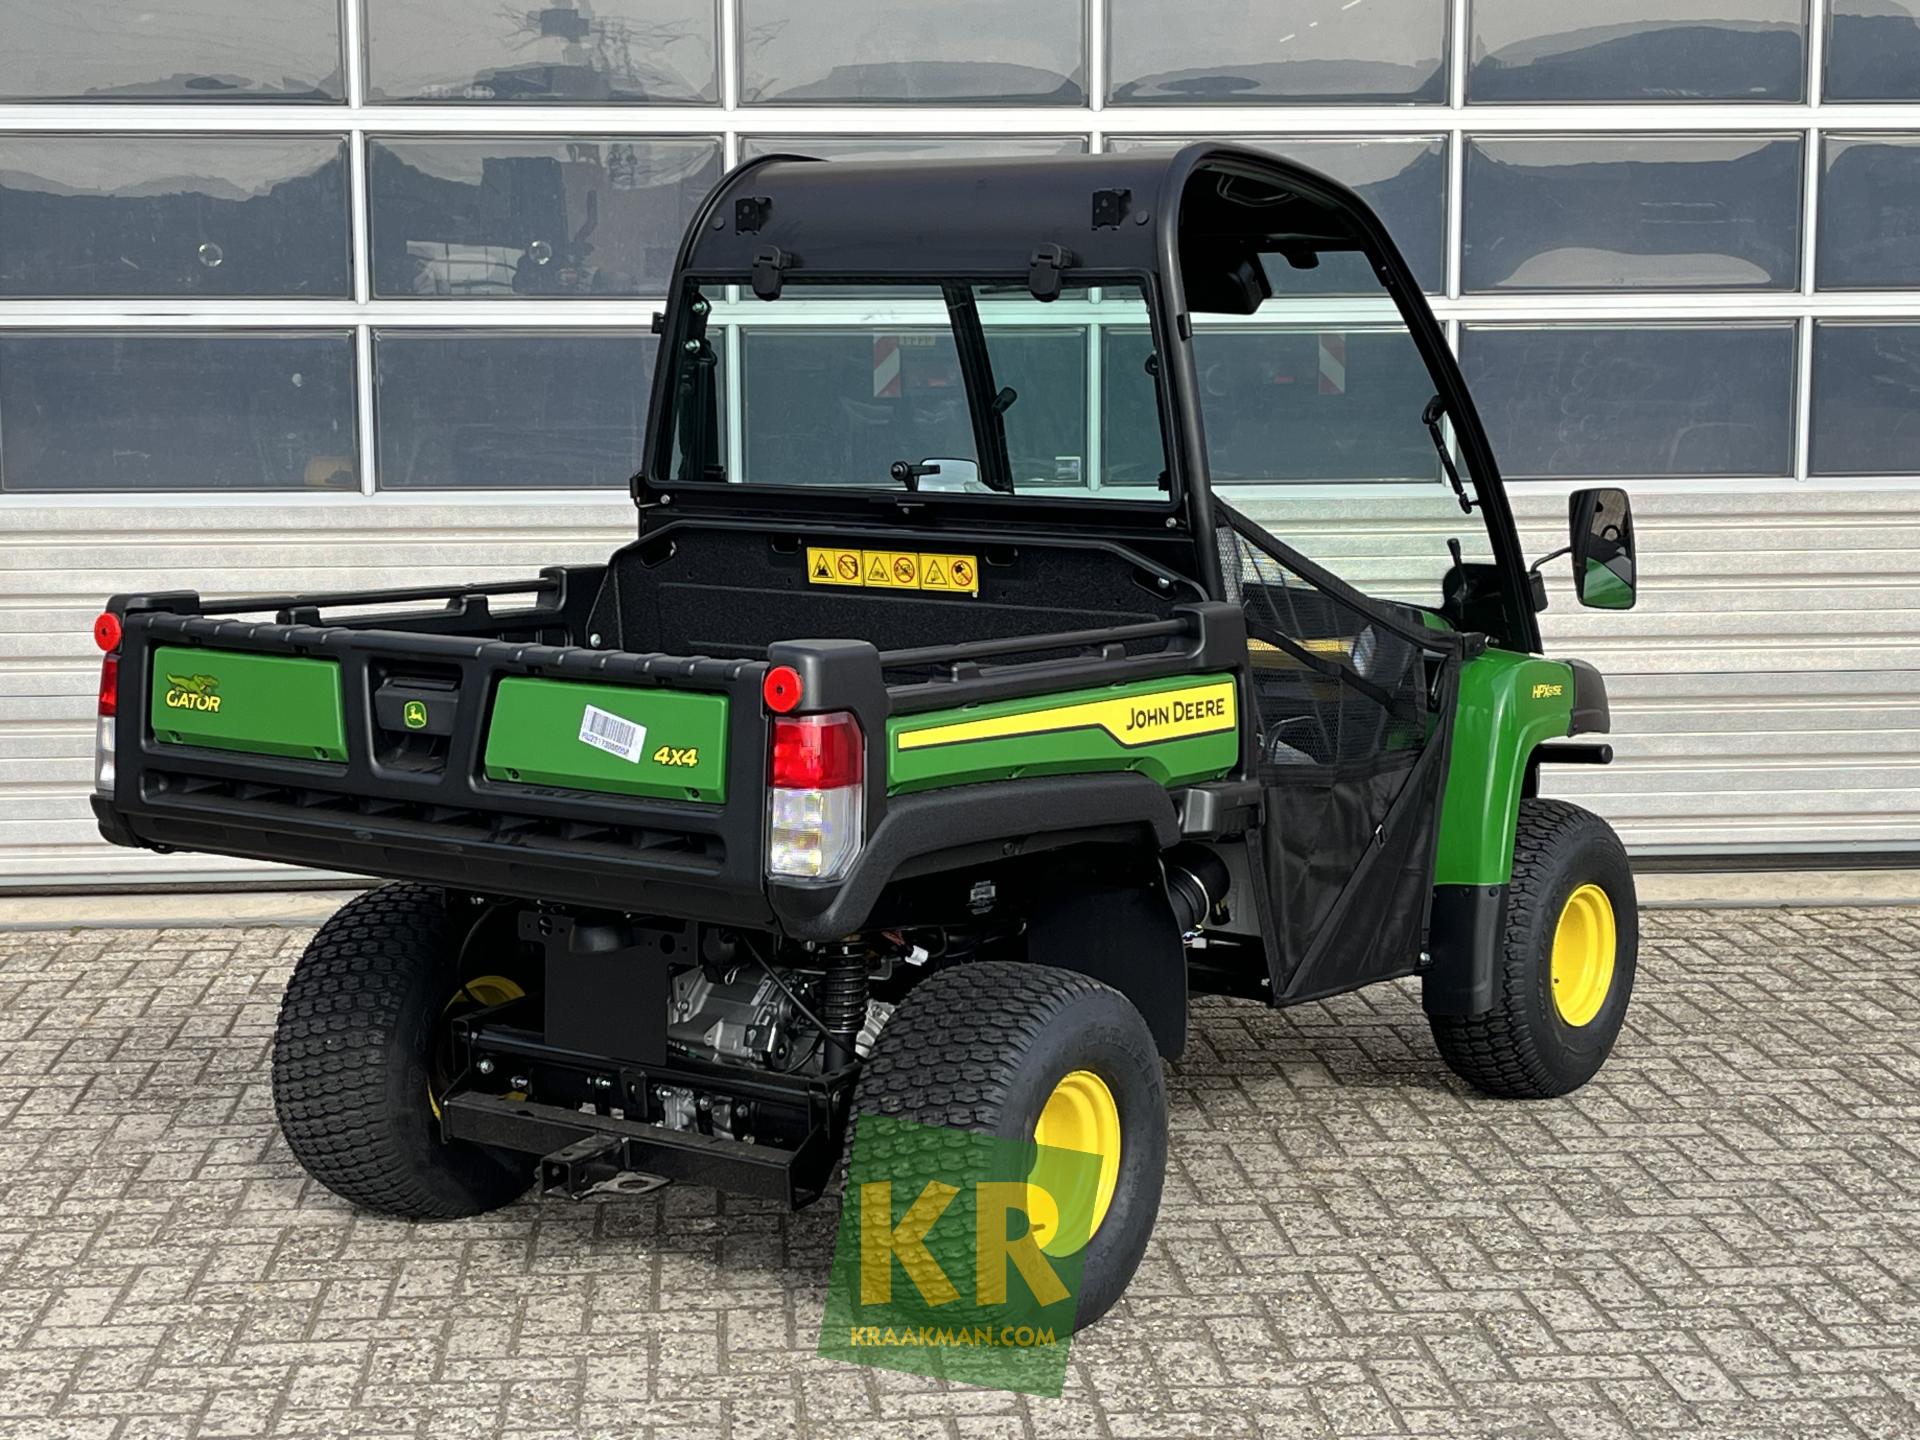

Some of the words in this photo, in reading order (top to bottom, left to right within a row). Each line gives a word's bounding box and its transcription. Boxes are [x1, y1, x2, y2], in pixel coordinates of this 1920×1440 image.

[165, 689, 221, 712] GATOR
[1126, 706, 1169, 731] JOHN
[1173, 698, 1225, 723] DEERE
